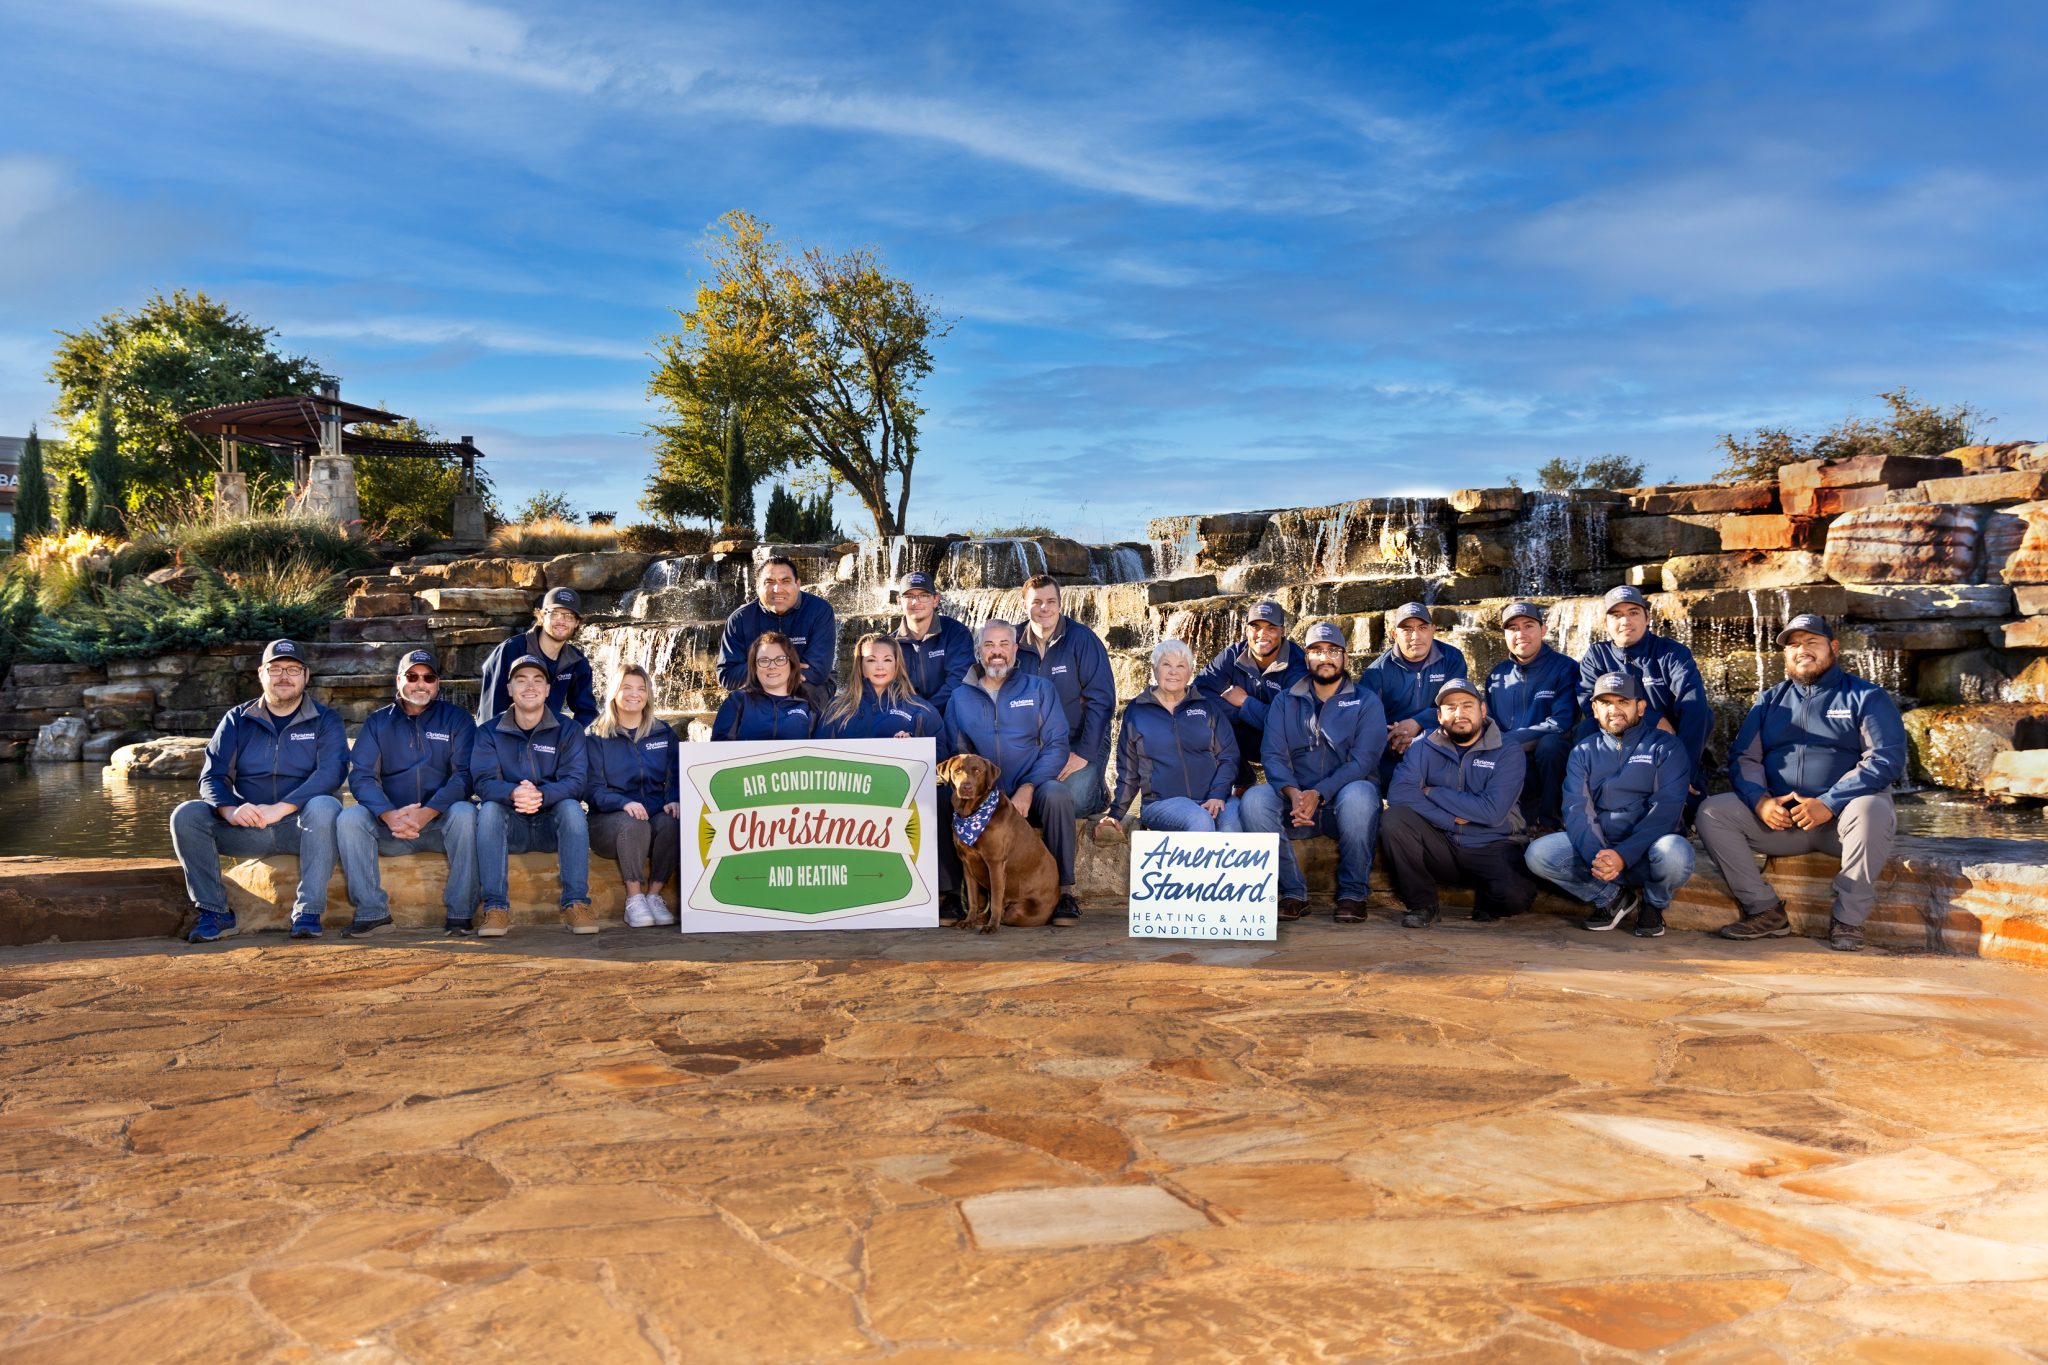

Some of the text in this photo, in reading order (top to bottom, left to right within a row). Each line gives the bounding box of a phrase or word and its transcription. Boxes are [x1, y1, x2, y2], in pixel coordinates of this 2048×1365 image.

[743, 770, 872, 797] AIR CONDITIONING
[728, 806, 893, 851] Christmas
[1140, 835, 1270, 870] American
[769, 865, 848, 887] AND HEATING
[1131, 871, 1273, 903] Standard
[1132, 925, 1265, 937] CONDITIONING
[1133, 912, 1266, 924] HEATING & AIR
